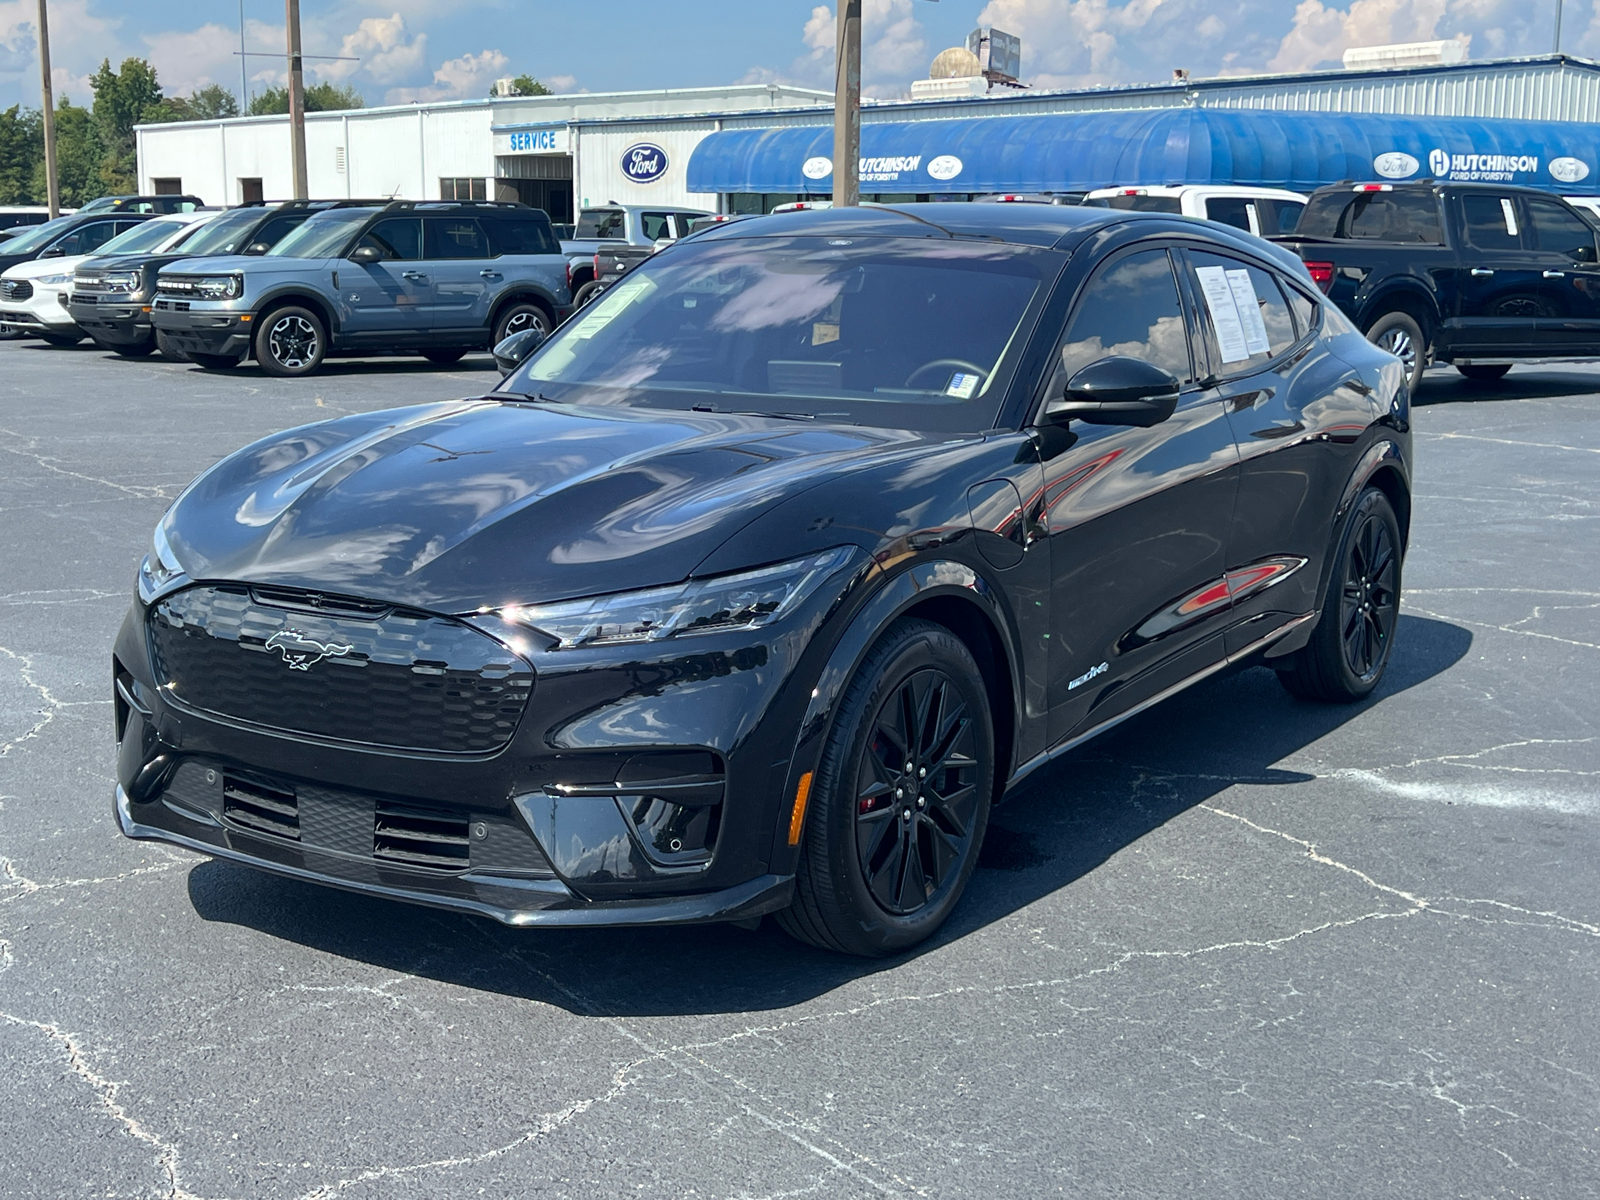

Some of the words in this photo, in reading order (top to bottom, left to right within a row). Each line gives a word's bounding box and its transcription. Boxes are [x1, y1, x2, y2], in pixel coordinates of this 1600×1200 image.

[510, 131, 556, 151] SERVICE
[628, 149, 658, 175] Ford
[807, 161, 826, 174] Ford
[859, 155, 921, 172] UTCHINSON
[933, 160, 954, 175] Ford
[1382, 157, 1410, 173] Ford
[1451, 154, 1538, 173] HUTCHINSON
[1557, 161, 1580, 176] Ford
[867, 173, 875, 181] OF
[874, 172, 899, 181] FORSYTH
[1449, 171, 1470, 180] FORD
[1470, 172, 1481, 180] OF
[1481, 172, 1514, 181] FORSYTH
